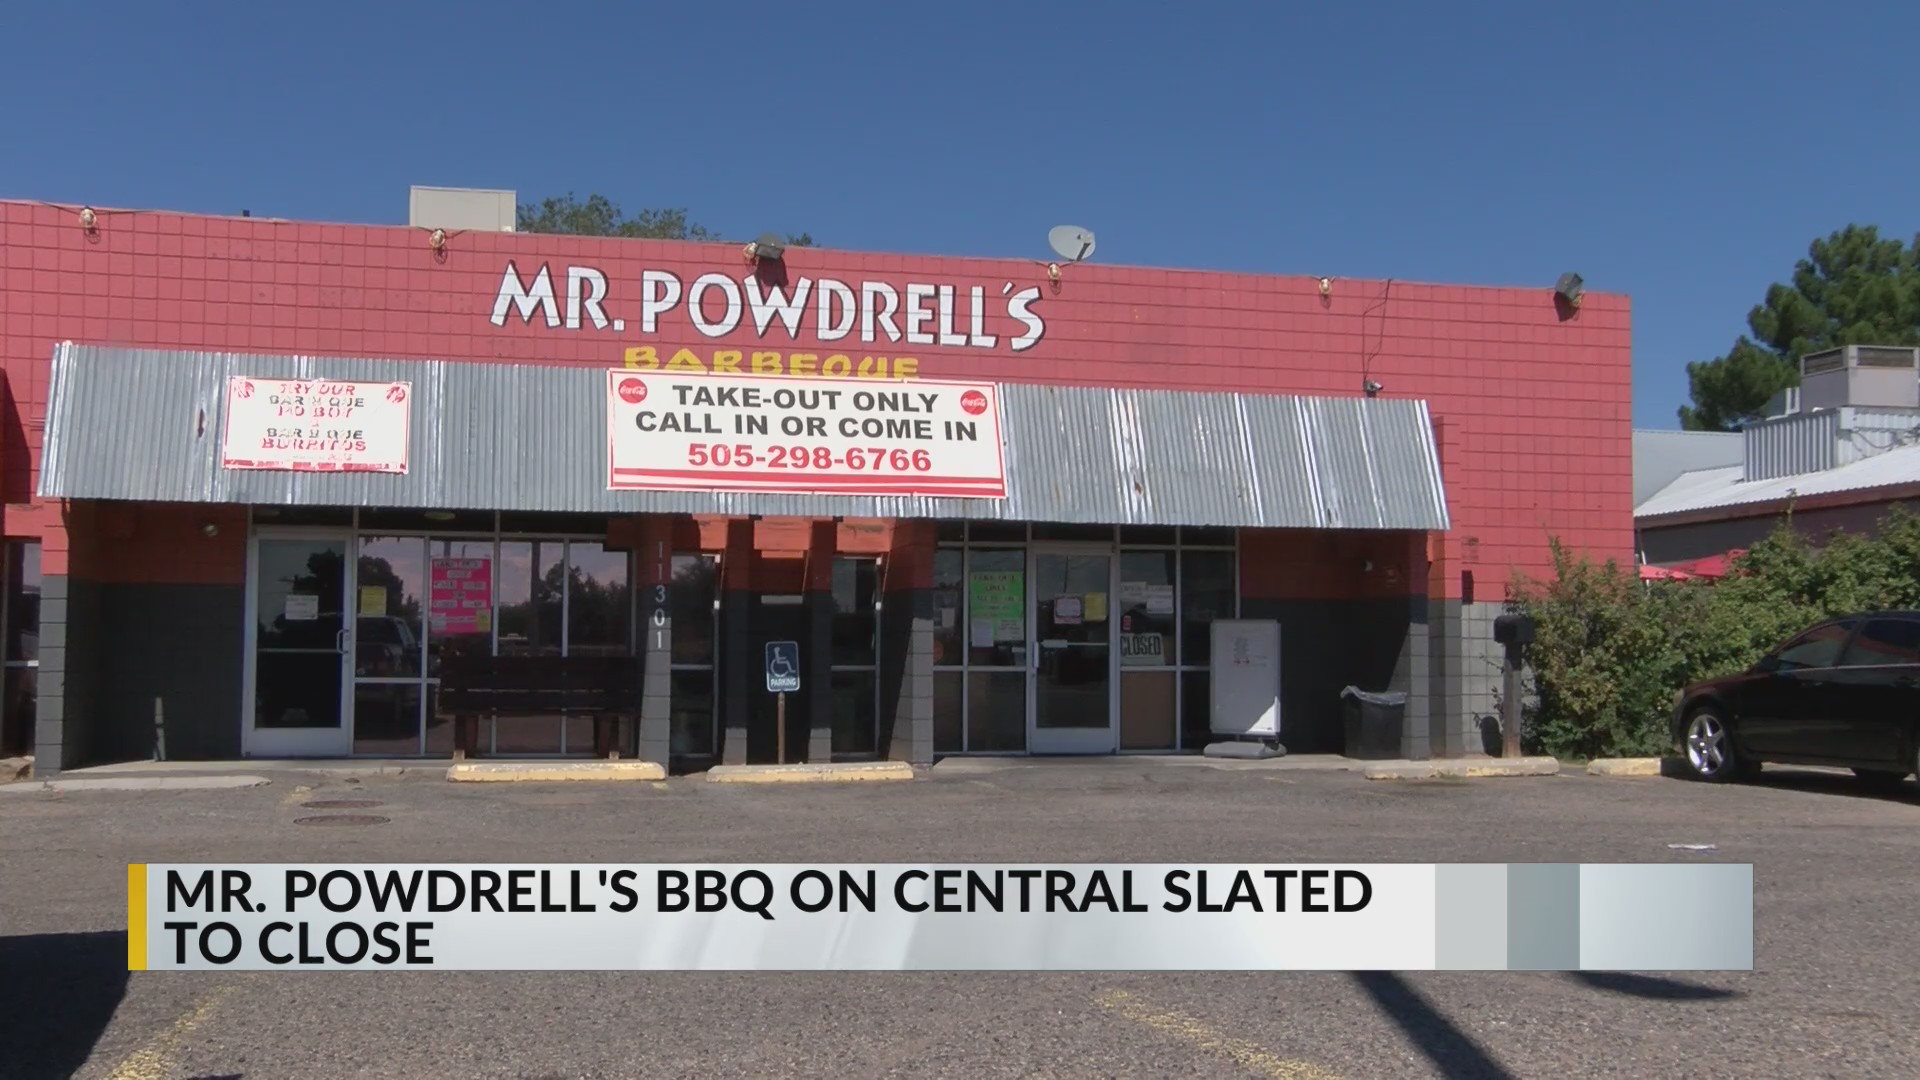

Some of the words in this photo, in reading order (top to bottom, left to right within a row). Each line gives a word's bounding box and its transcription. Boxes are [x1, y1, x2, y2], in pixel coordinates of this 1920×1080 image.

[490, 260, 626, 333] MR.
[641, 270, 1047, 352] POWDRELL'S
[672, 385, 842, 411] TAKE-OUT
[853, 391, 939, 413] ONLY
[635, 411, 722, 434] CALL
[735, 414, 768, 435] IN
[781, 415, 828, 437] OR
[838, 418, 933, 440] COME
[944, 421, 977, 441] IN
[688, 443, 932, 472] 505-298-6766
[654, 541, 666, 649] 11301
[1120, 635, 1162, 656] CLOSED
[770, 677, 797, 687] PARKING
